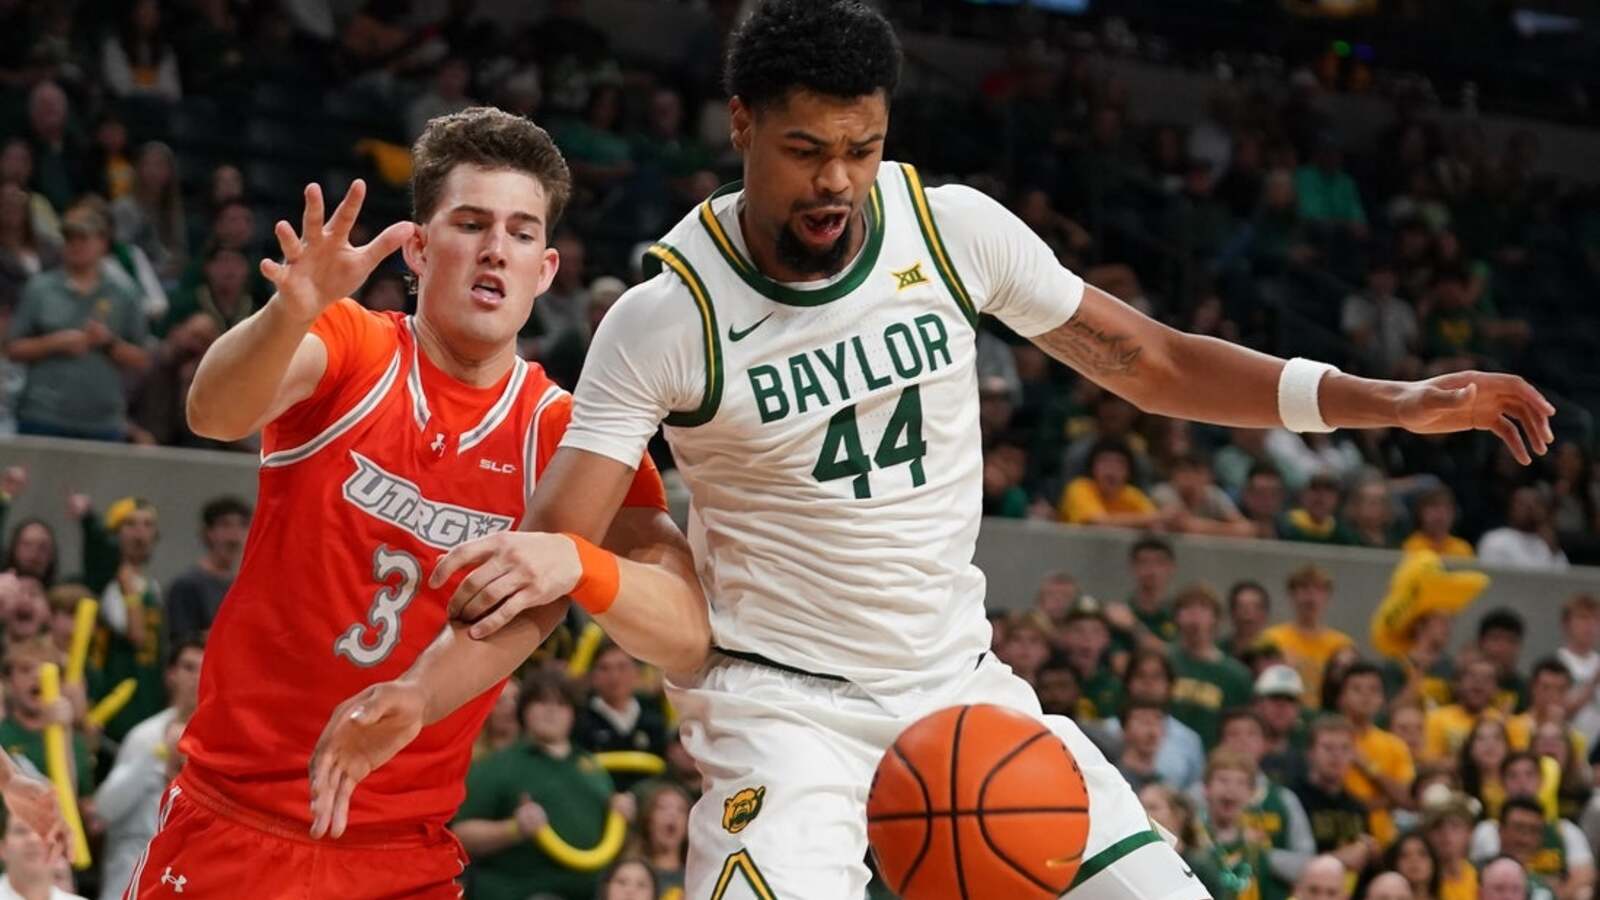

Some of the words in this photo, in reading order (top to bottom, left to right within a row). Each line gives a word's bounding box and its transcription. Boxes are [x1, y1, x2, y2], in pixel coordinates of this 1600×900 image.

[747, 313, 952, 424] BAYLOR
[479, 458, 516, 473] SLC
[811, 383, 928, 499] 44
[335, 544, 422, 667] 3
